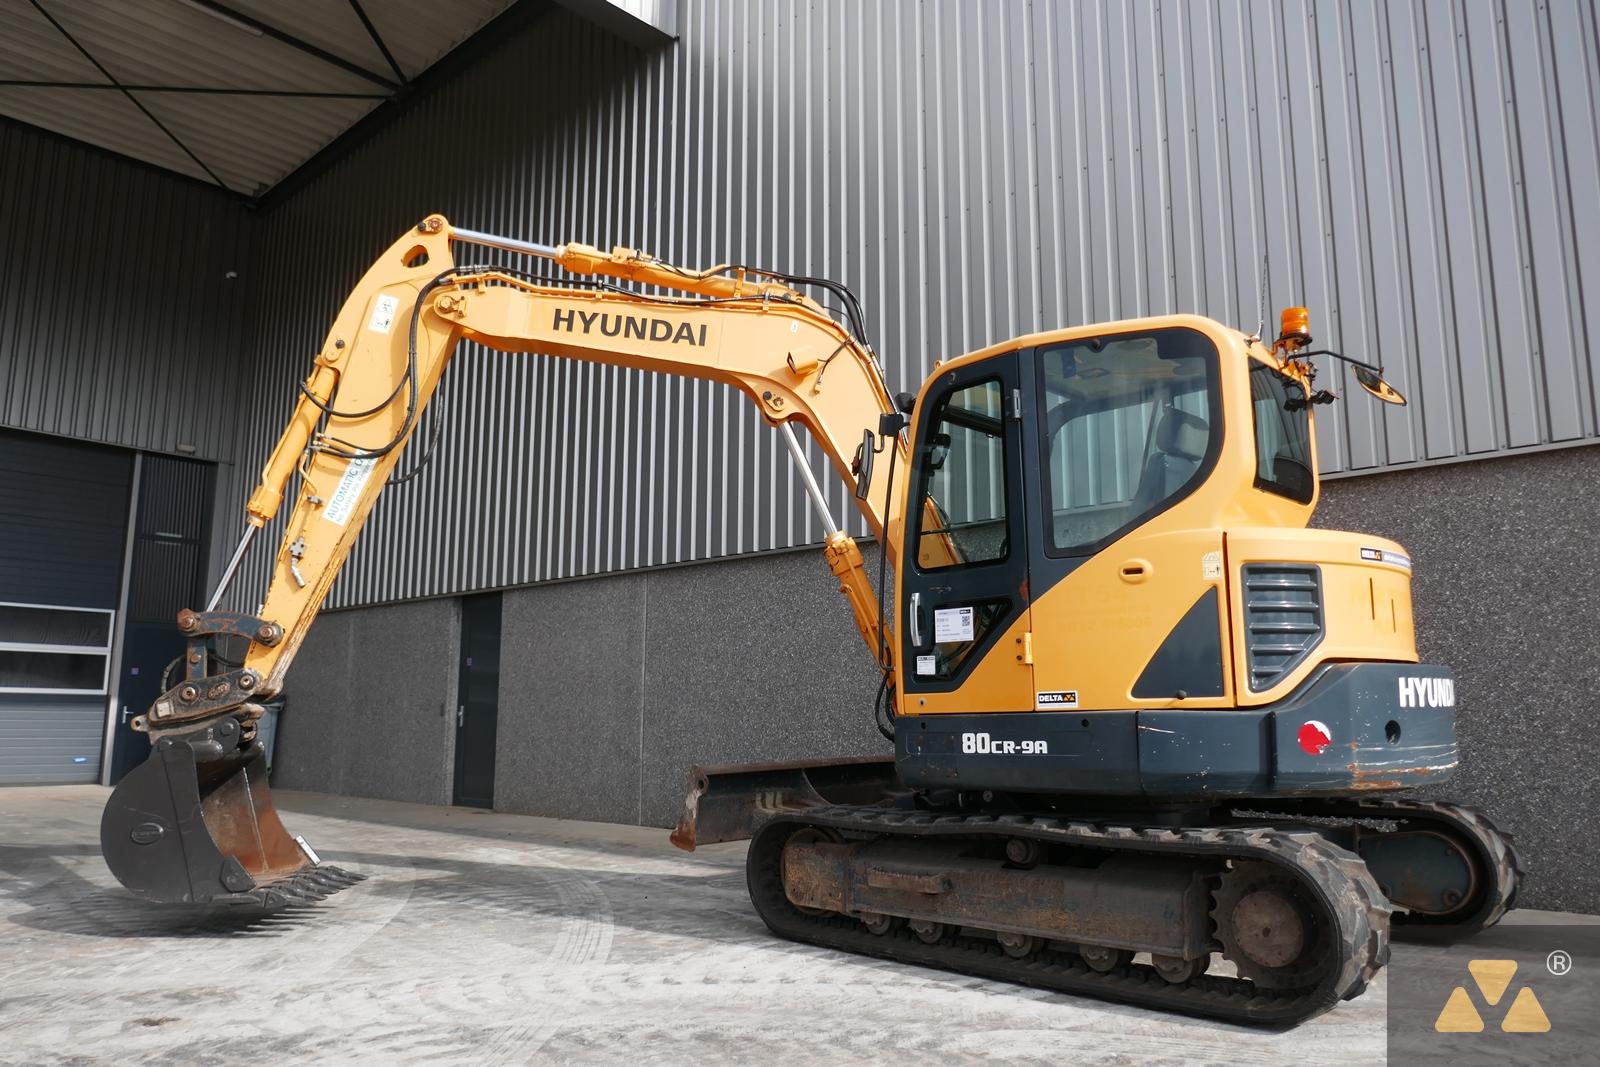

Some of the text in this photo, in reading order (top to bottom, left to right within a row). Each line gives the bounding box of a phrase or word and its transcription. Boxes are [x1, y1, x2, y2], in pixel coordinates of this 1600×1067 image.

[553, 308, 707, 347] HYUNDAI
[327, 467, 359, 519] AUTOMATIC
[1039, 694, 1063, 703] DELTA
[962, 733, 1048, 754] 80CR-9A
